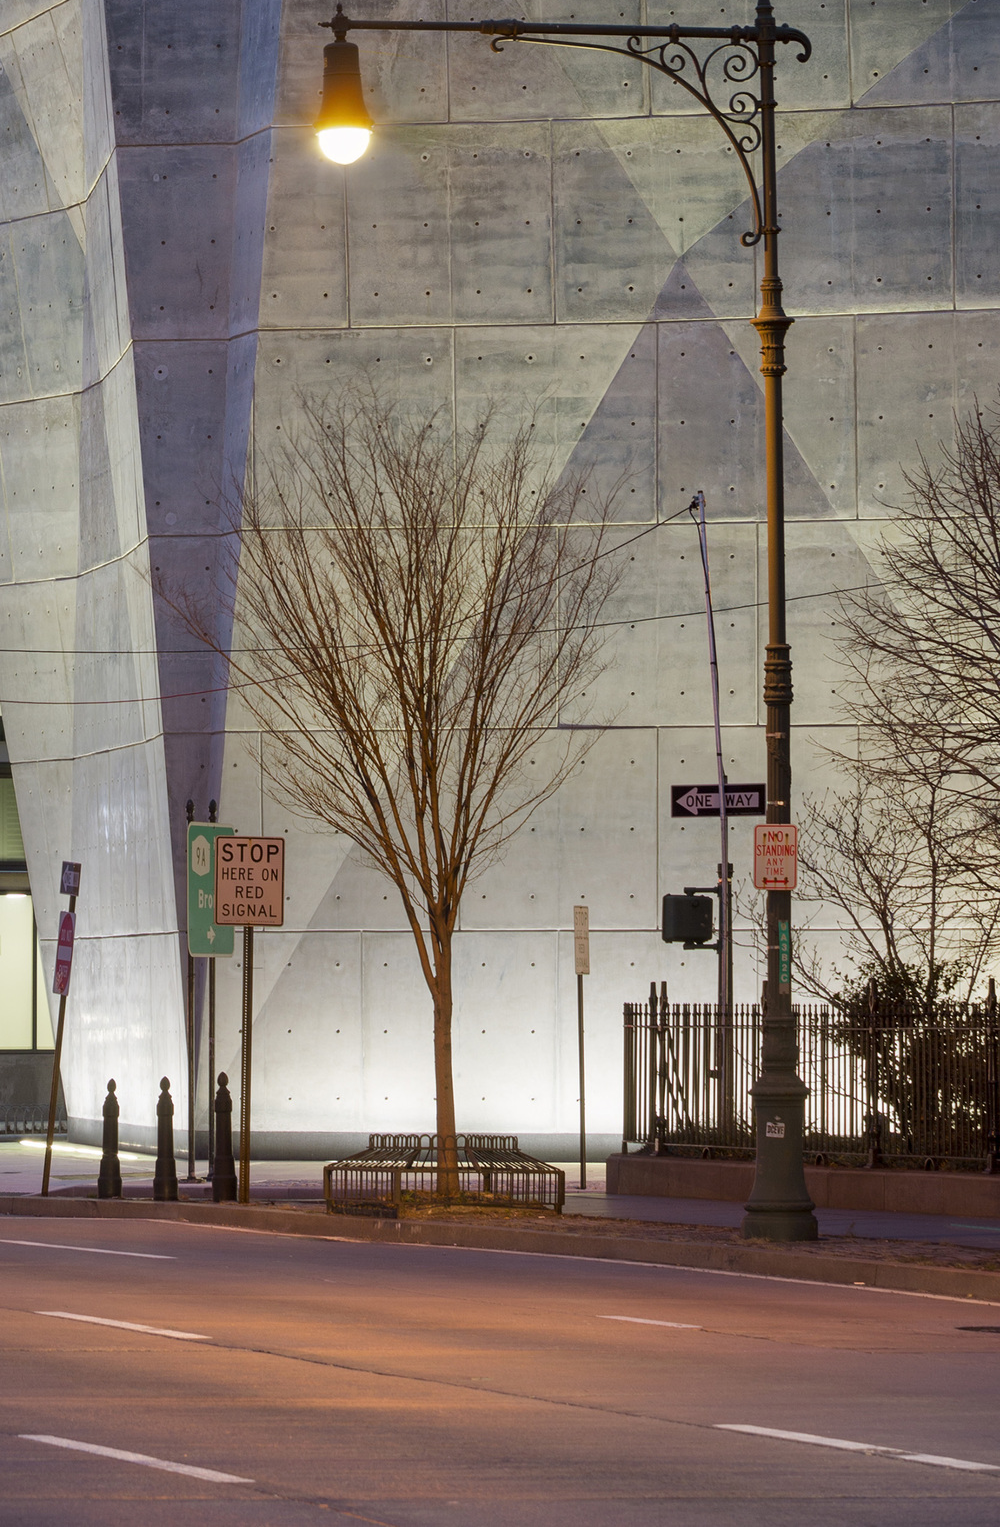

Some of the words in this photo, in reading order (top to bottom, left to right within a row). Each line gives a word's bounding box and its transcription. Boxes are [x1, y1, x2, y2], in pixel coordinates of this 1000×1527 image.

[686, 795, 712, 807] ONE
[725, 794, 753, 806] WAY
[768, 830, 783, 842] NO
[196, 846, 205, 866] 9A
[221, 843, 279, 863] STOP
[756, 844, 795, 856] STANDING
[766, 858, 783, 866] ANY
[221, 867, 254, 880] HERE
[261, 868, 278, 881] ON
[766, 867, 784, 876] TIME
[198, 889, 214, 909] Bro
[235, 886, 264, 899] RED
[221, 903, 277, 918] SIGNAL
